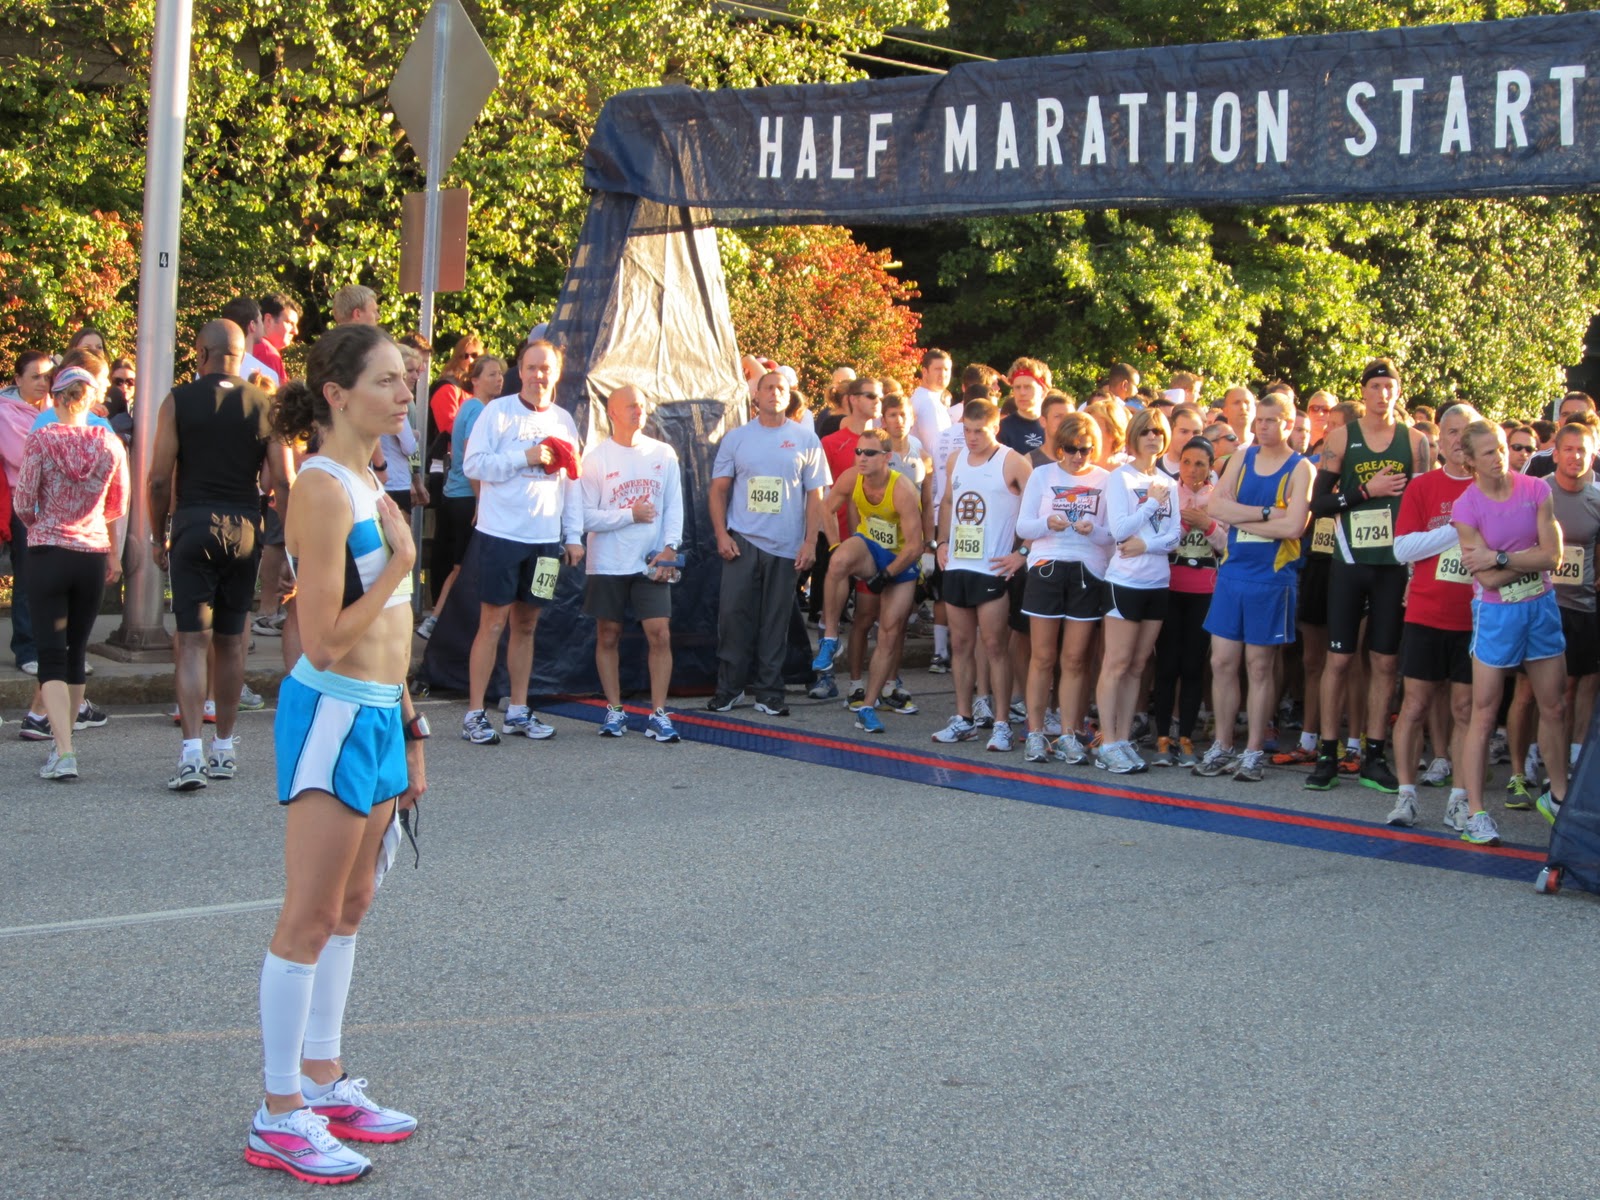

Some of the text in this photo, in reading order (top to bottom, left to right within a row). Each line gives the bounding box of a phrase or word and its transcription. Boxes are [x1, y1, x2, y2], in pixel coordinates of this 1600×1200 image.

[758, 65, 1586, 179] HALF MARATHON START
[160, 253, 168, 267] 4
[1354, 459, 1405, 474] GREATER
[612, 478, 662, 496] LAWRENCE
[750, 489, 779, 503] 4348
[869, 528, 894, 545] 4363
[1355, 525, 1389, 541] 4734
[1440, 557, 1473, 577] 398
